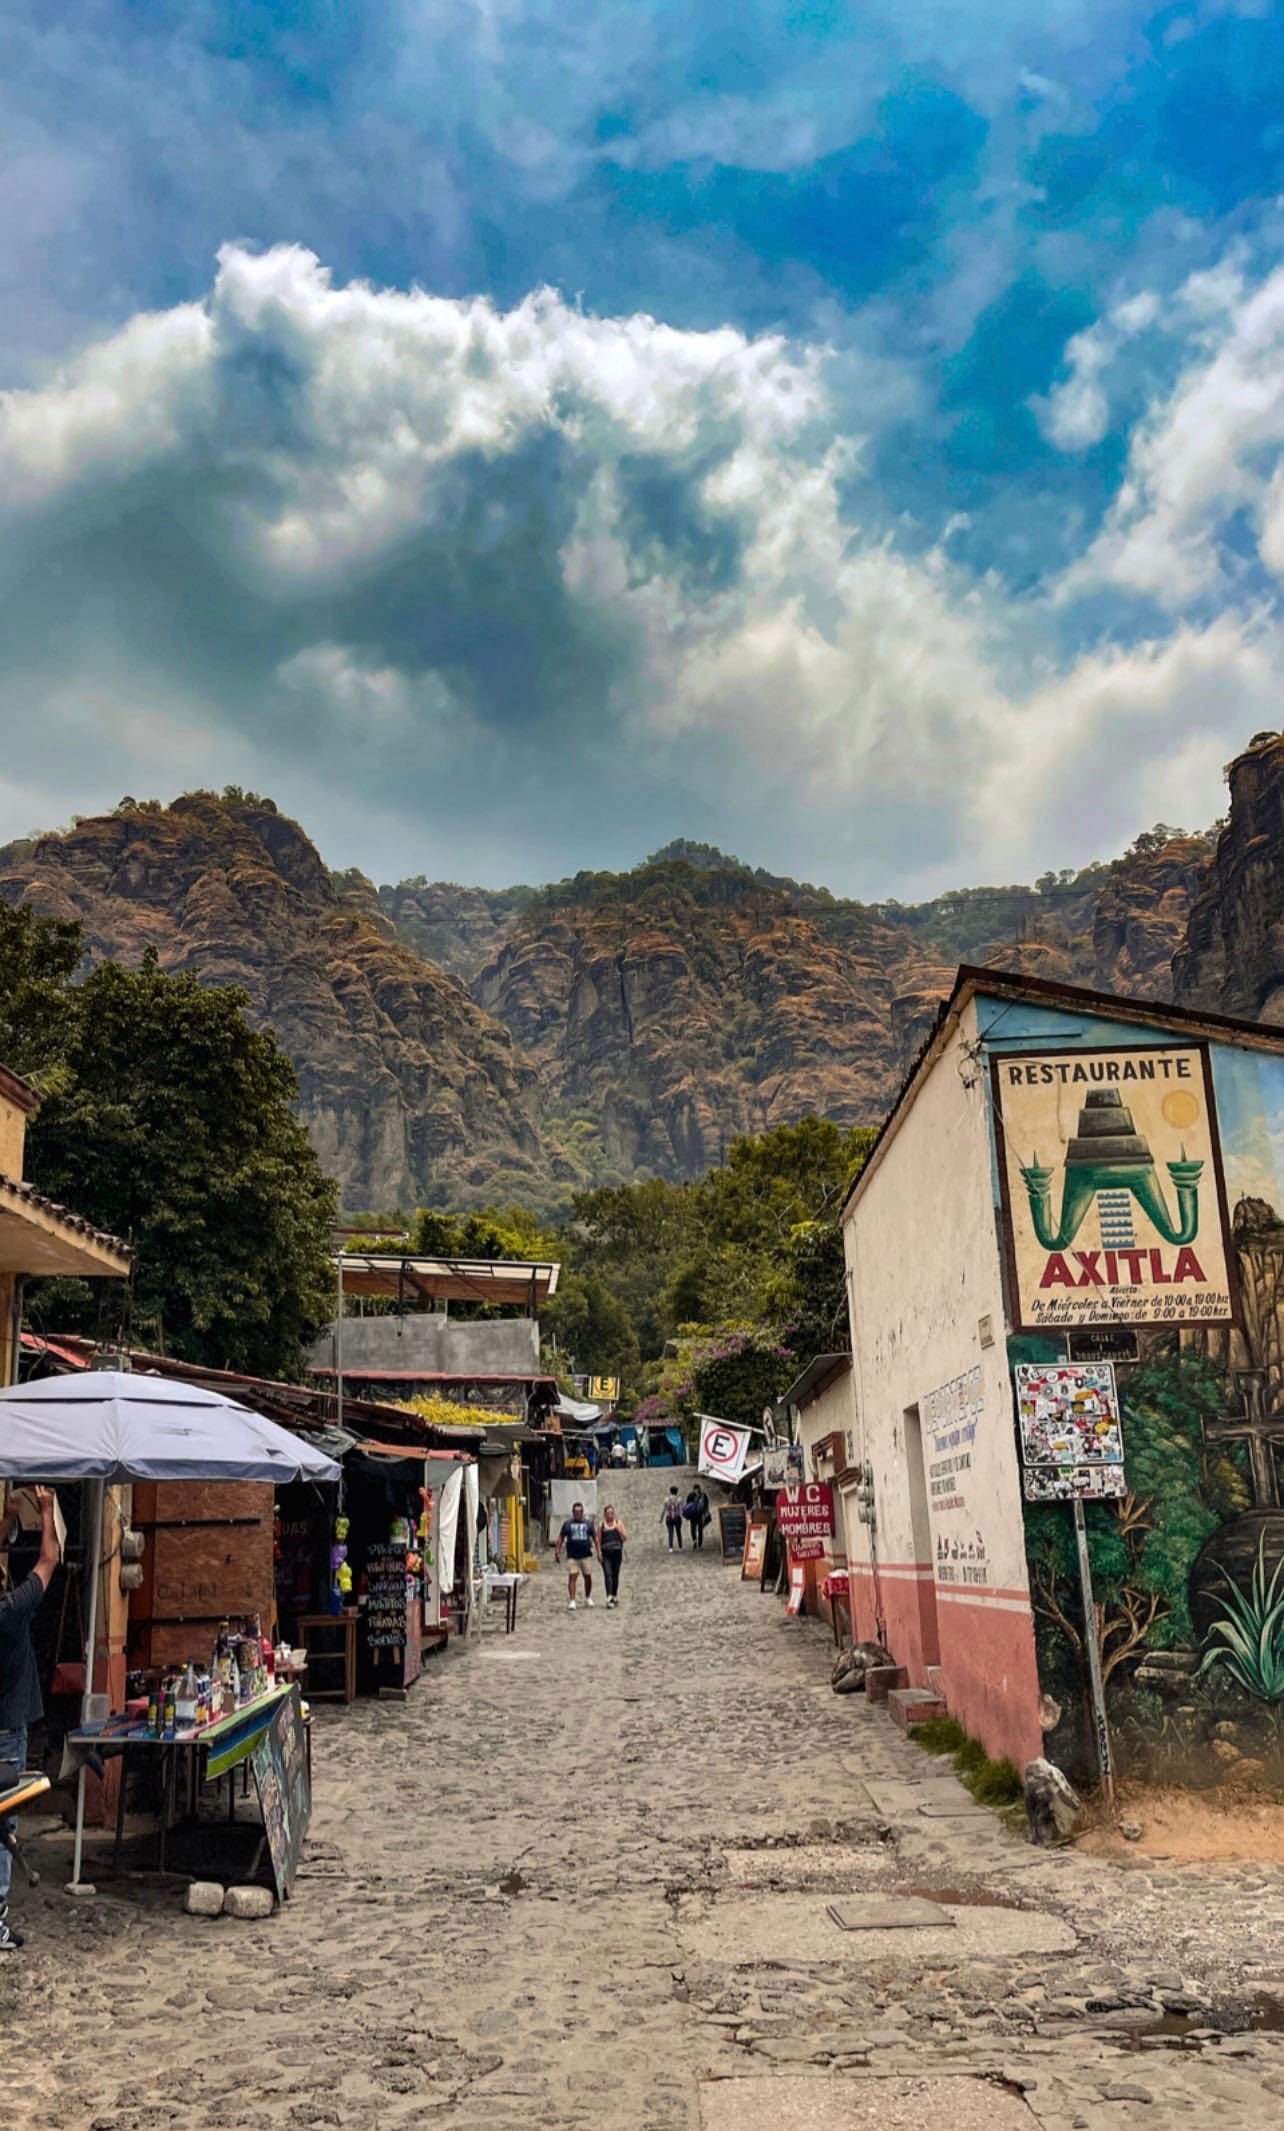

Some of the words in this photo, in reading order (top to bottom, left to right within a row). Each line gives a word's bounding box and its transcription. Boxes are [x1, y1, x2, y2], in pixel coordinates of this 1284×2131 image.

[1009, 1058, 1191, 1085] RESTAURANTE
[1039, 1247, 1208, 1288] AXITLA
[1032, 1299, 1045, 1311] De
[1101, 1300, 1108, 1308] a
[1151, 1296, 1162, 1306] de
[1079, 1313, 1086, 1323] y
[1135, 1310, 1147, 1319] de
[1153, 1307, 1176, 1318] 9:00
[601, 1376, 609, 1391] E
[712, 1433, 730, 1457] E
[780, 1504, 829, 1518] MUJERES
[782, 1522, 831, 1535] HOMBRES
